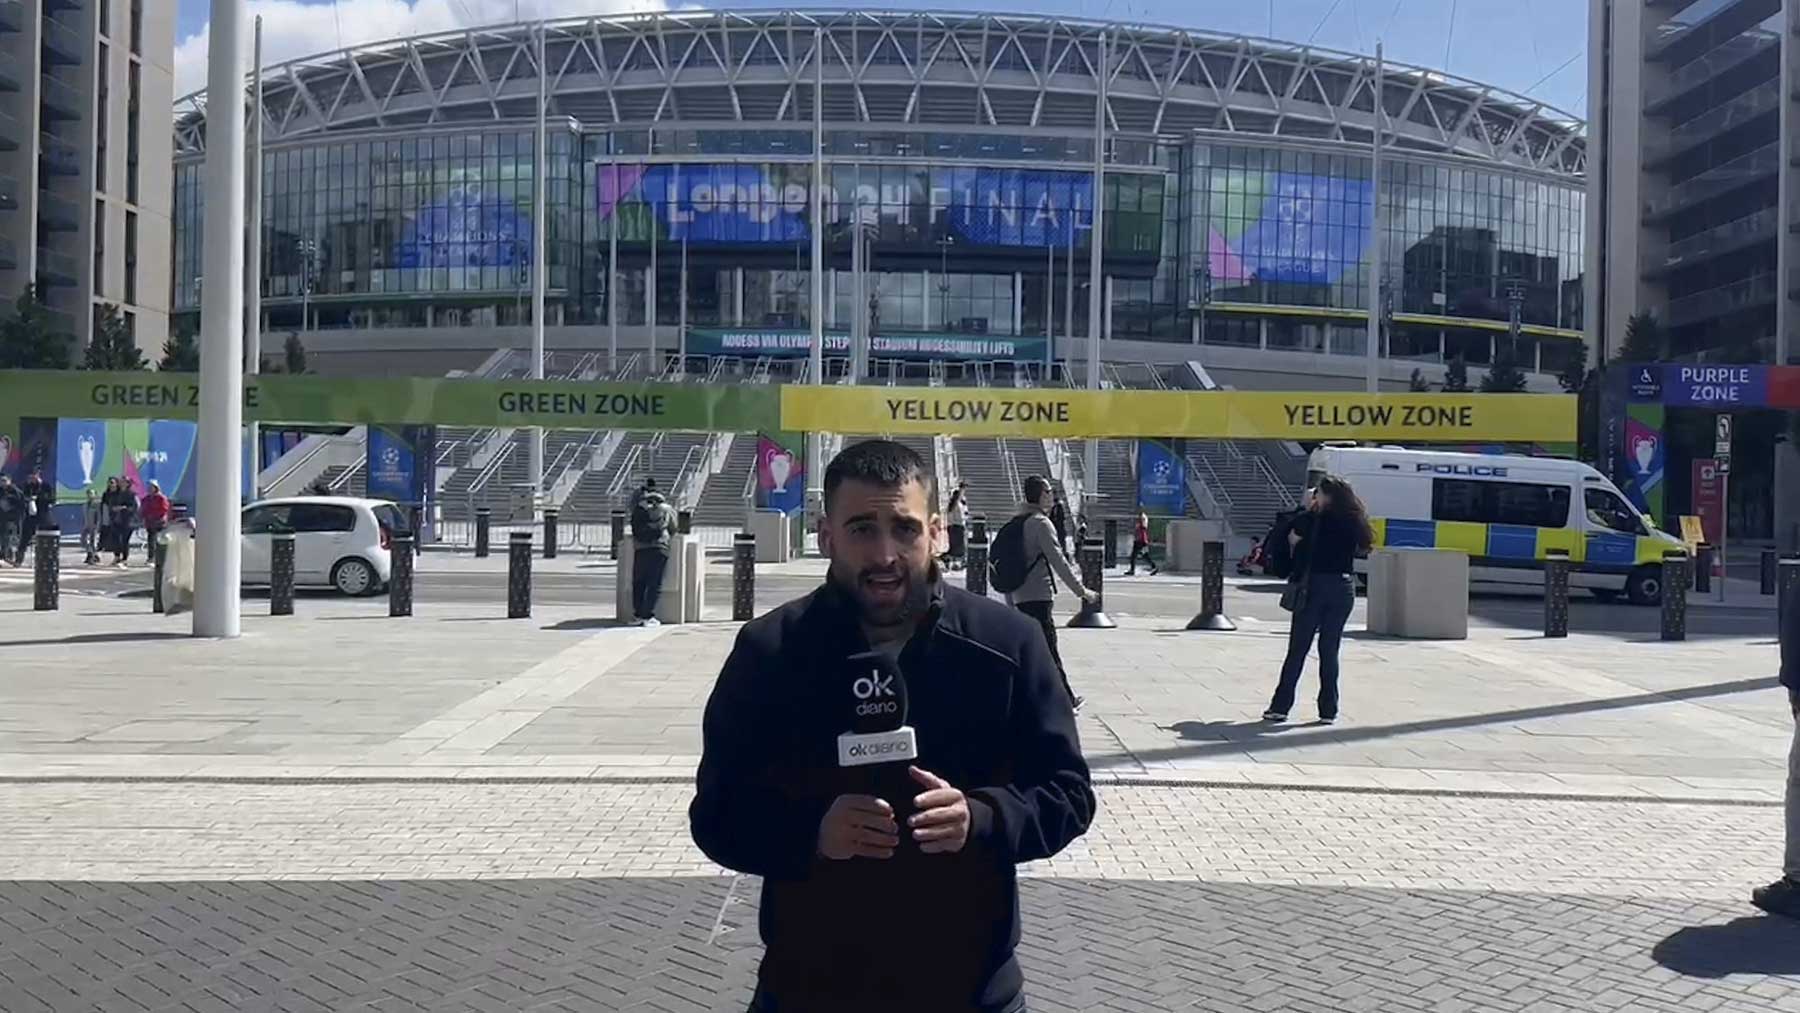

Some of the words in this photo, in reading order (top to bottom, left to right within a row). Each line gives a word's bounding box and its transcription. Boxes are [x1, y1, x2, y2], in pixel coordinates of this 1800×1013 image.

[930, 186, 1092, 230] FINAL
[722, 334, 760, 347] ACCESS
[761, 335, 777, 347] VIA
[825, 336, 851, 349] STEP
[873, 337, 917, 350] STADIUM
[990, 341, 1014, 355] LIFTS
[1681, 368, 1749, 383] PURPLE
[92, 384, 178, 406] GREEN
[188, 386, 259, 407] ZE
[499, 392, 586, 414] GREEN
[594, 395, 665, 415] ZONE
[1691, 386, 1739, 400] ZONE
[887, 399, 992, 421] YELLOW
[1000, 401, 1069, 422] ZONE
[1284, 404, 1393, 426] YELLOW
[1401, 406, 1472, 427] ZONE
[1416, 463, 1508, 477] POLICE
[853, 669, 895, 699] ok
